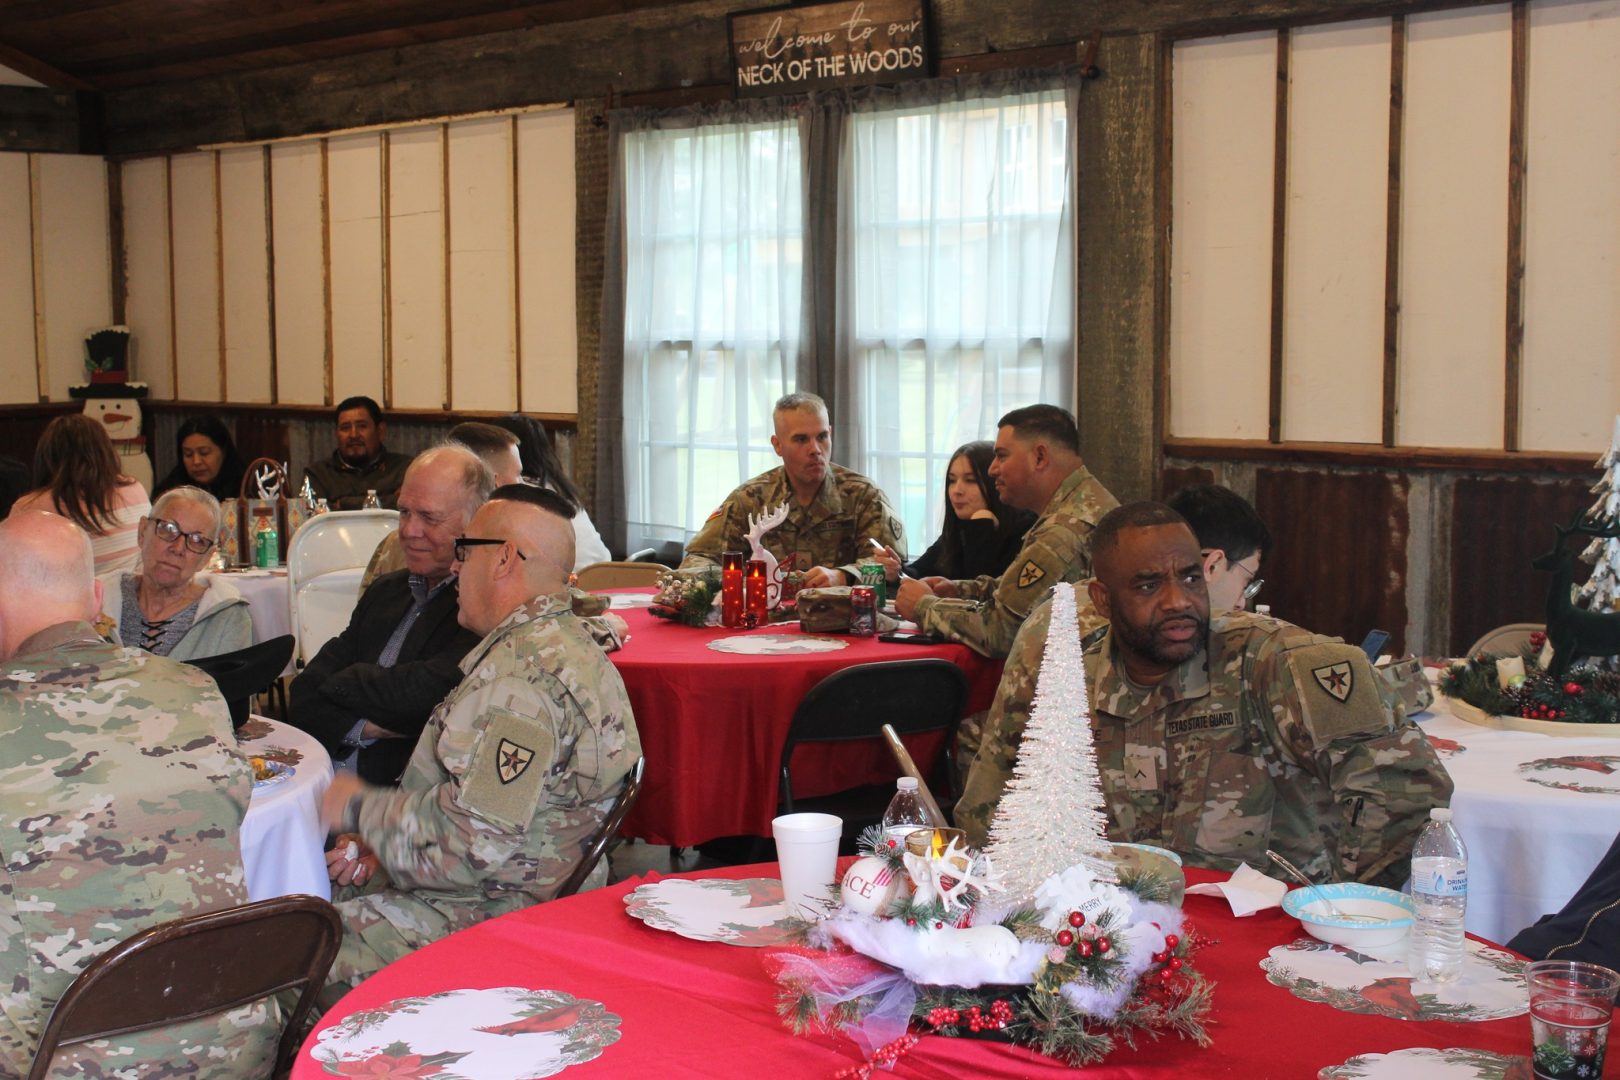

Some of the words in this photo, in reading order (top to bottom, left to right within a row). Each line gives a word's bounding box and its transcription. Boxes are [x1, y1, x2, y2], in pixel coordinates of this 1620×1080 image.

[738, 16, 836, 59] welcome
[840, 2, 876, 42] to
[887, 20, 920, 35] our
[738, 61, 784, 87] NECK
[787, 57, 812, 81] OF
[814, 54, 845, 78] THE
[849, 45, 923, 74] WOODS
[861, 571, 884, 585] rite
[1168, 719, 1188, 735] TEXAS
[1188, 715, 1209, 731] STATE
[1209, 712, 1234, 727] GUARD
[843, 871, 876, 899] ACE
[1078, 897, 1103, 913] MERRY
